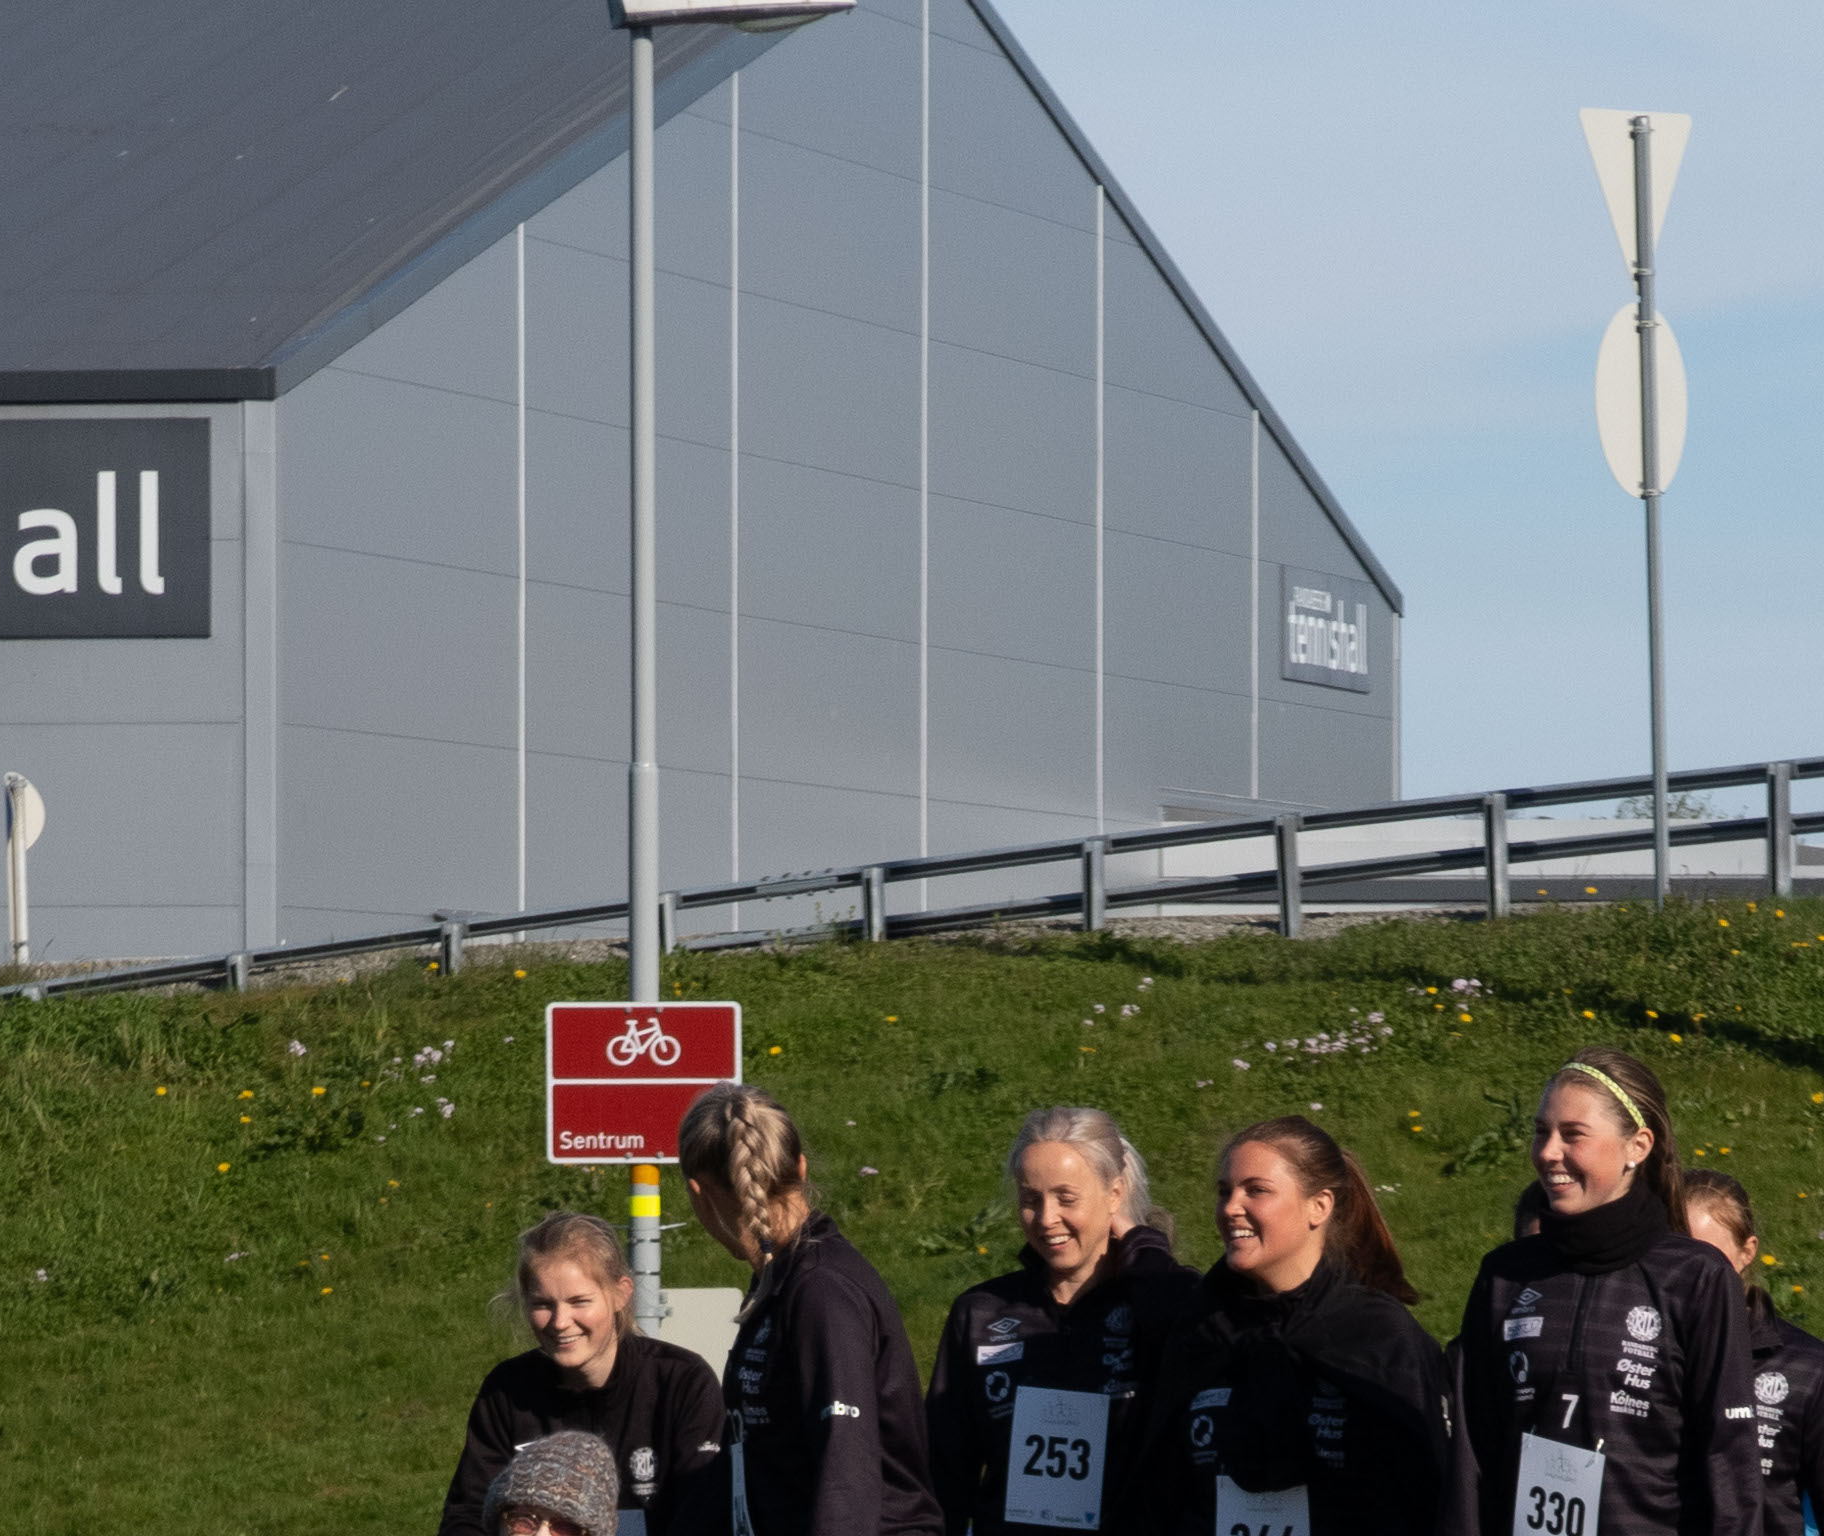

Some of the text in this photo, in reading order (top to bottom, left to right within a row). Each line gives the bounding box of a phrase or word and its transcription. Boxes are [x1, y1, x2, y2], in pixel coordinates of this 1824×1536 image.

[559, 1130, 645, 1150] Sentrum
[1616, 1358, 1656, 1376] Øster
[1624, 1374, 1651, 1389] Hus
[1562, 1394, 1580, 1429] 7
[1023, 1434, 1091, 1481] 253
